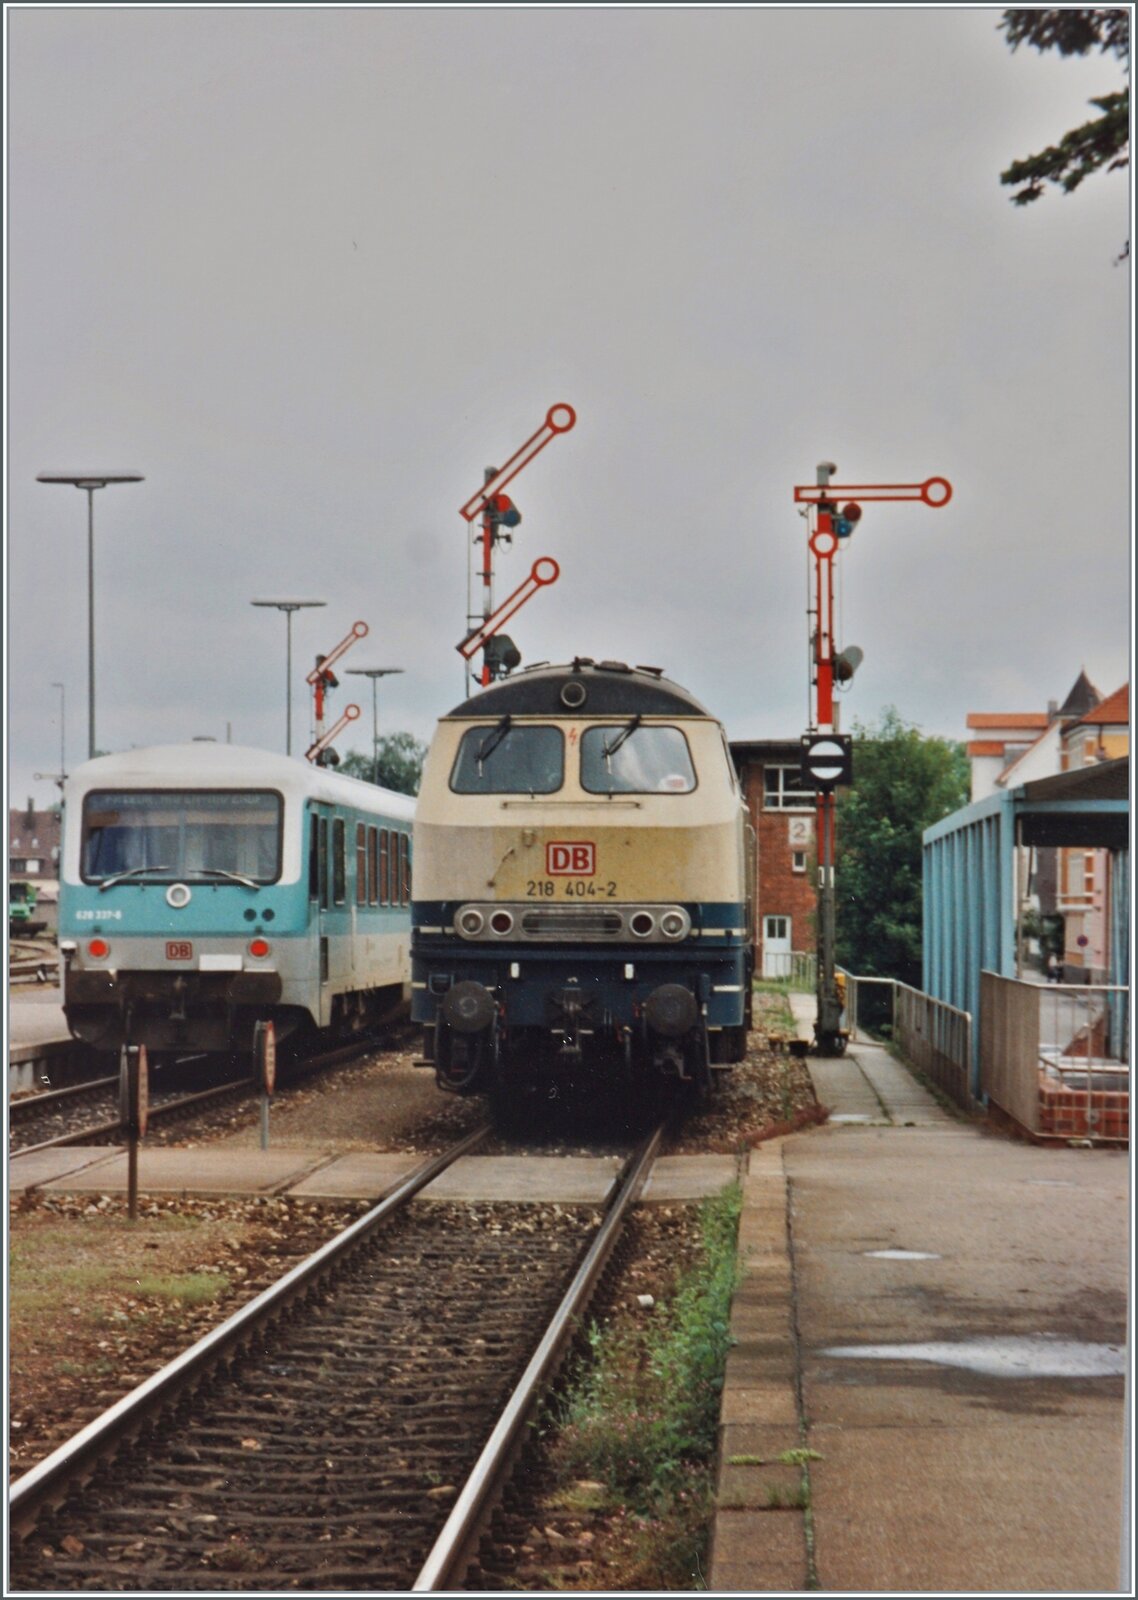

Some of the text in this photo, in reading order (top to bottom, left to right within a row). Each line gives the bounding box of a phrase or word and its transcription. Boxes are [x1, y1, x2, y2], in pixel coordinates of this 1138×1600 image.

[792, 822, 806, 840] 2
[551, 847, 590, 871] DB
[527, 881, 617, 896] 218 404-2
[168, 944, 190, 958] DB
